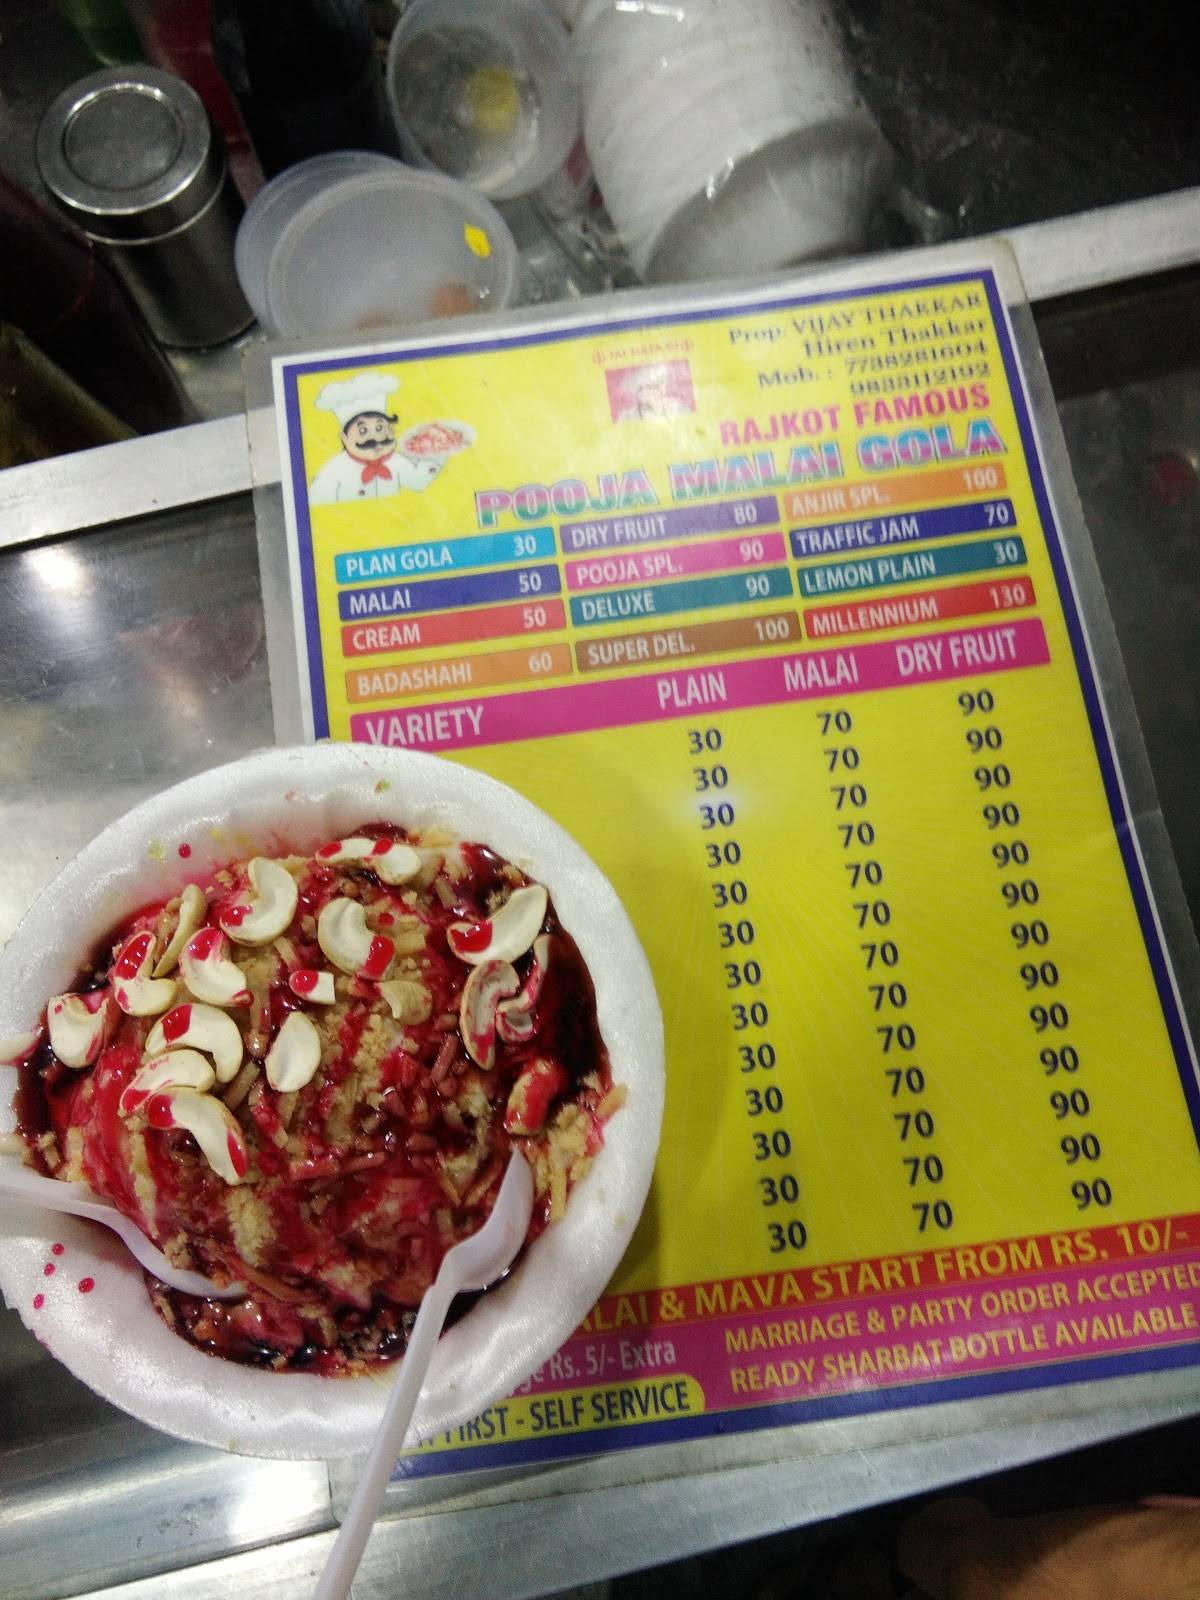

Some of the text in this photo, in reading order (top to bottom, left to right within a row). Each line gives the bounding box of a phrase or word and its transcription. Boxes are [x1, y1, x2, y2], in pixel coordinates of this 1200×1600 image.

[792, 311, 854, 334] VIJAY
[864, 293, 981, 325] THAKKAR
[804, 319, 987, 359] Hiren Thakkar
[719, 384, 991, 447] RAJKOT FAMOUS
[473, 418, 1008, 528] POOJA MALAI GOLA
[791, 466, 998, 517] ANJIR SPL. 100
[346, 535, 537, 577] PLAN GOLA 30
[571, 502, 758, 549] DRY FRUIT 80
[796, 504, 1009, 555] TRAFFIC JAM 70
[350, 572, 542, 615] MALAI 50
[576, 539, 764, 585] POOJA SPL. 90
[804, 543, 1019, 594] LEMON PLAIN 30
[352, 607, 547, 650] CREAM 50
[581, 574, 770, 621] DELUXE 90
[812, 583, 1026, 637] MILLENNIUM 130
[587, 618, 790, 667] SUPER DEL. 100
[357, 653, 553, 697] BADASHAHI 60
[365, 629, 1018, 746] VARIETY PLAIN MALAI DRY FRUIT
[688, 689, 994, 754] 30 70 90
[694, 727, 1003, 791] 30 70 90
[699, 764, 1011, 829] 30 70 90
[705, 802, 1020, 868] 30 70 90
[710, 840, 1030, 908] 30 70 90
[717, 879, 1040, 948] 30 70 90
[723, 920, 1049, 989] 30 70 90
[730, 961, 1059, 1031] 30 70 90
[737, 1002, 1069, 1073] 30 70 90
[744, 1045, 1080, 1117] 30 70 90
[751, 1088, 1090, 1162] 30 70 90
[758, 1133, 1101, 1207] 30 70 90
[766, 1177, 1113, 1254] 30 70 90
[659, 1290, 686, 1321] &
[695, 1273, 802, 1316] MAVA
[813, 1257, 926, 1300] START
[933, 1240, 1042, 1283] FROM
[1050, 1230, 1108, 1265] RS.
[1115, 1218, 1189, 1257] 10/-
[725, 1310, 860, 1353] MARRIAGE
[867, 1310, 887, 1335] &
[892, 1296, 974, 1329] PARTY
[981, 1281, 1072, 1318] ORDER
[729, 1302, 1199, 1394] READY SHARBAT BOTTLE AVAILABLE
[549, 1351, 581, 1381] Rs.
[586, 1343, 615, 1376] 5/-
[619, 1339, 677, 1371] Extra
[530, 1397, 583, 1432] SELF
[592, 1382, 690, 1423] SERVICE
